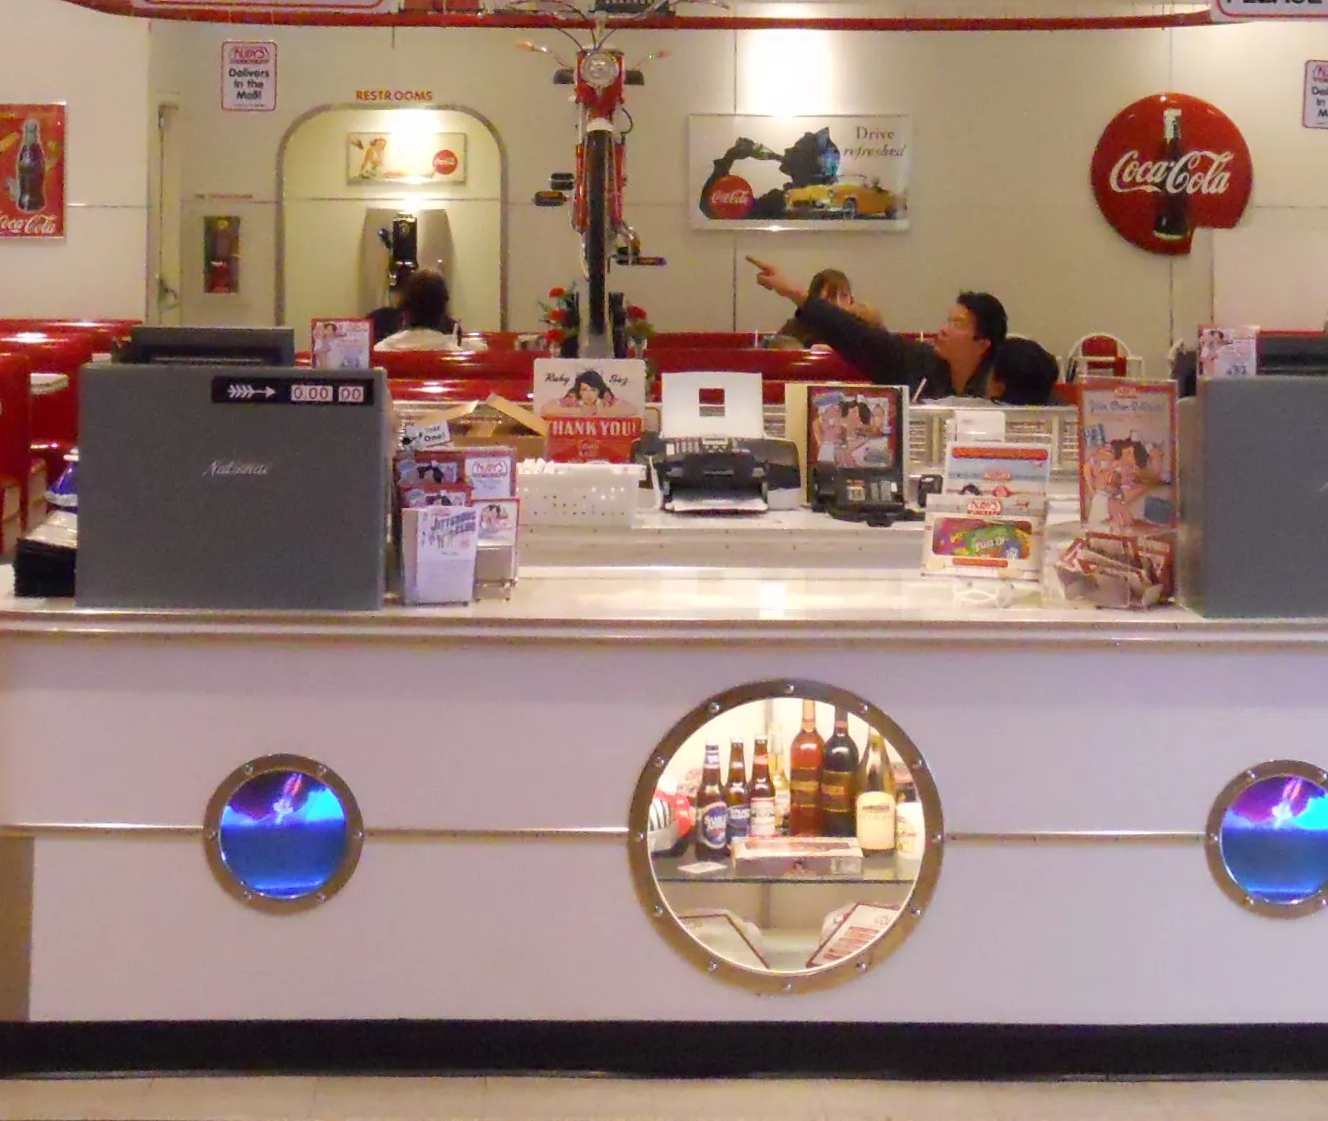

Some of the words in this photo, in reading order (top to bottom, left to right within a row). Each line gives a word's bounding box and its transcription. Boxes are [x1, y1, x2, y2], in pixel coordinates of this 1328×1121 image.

[355, 90, 434, 101] RESTROOMS
[856, 126, 896, 140] Drive
[842, 144, 907, 159] refreshed
[1109, 149, 1235, 195] Coca-Cola
[544, 371, 571, 387] Ruby
[549, 420, 597, 437] HANK
[599, 420, 637, 437] YOU!
